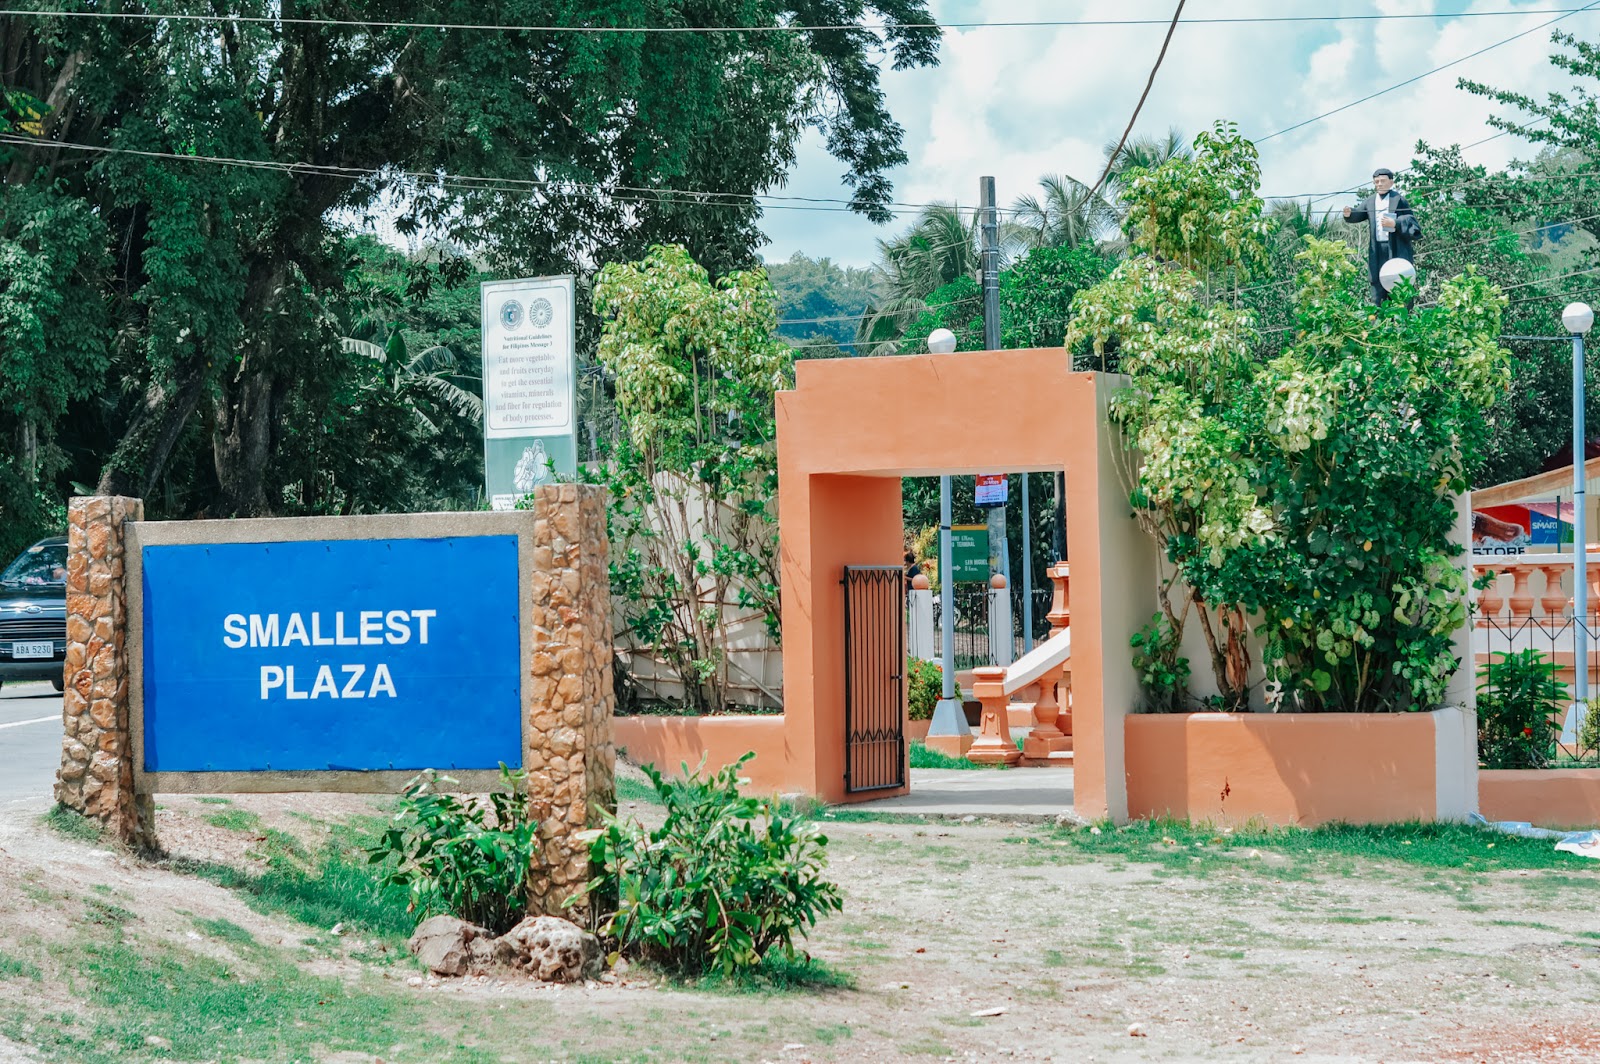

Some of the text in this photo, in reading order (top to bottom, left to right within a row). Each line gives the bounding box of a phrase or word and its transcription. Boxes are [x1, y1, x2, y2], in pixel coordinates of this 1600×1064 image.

[526, 354, 555, 363] vegetables
[511, 366, 527, 375] fruits
[528, 365, 554, 374] everyday
[508, 380, 517, 388] get
[518, 378, 527, 386] the
[529, 377, 553, 386] essential
[529, 389, 554, 397] minerals
[496, 402, 506, 411] and
[507, 402, 521, 410] fiber
[532, 400, 562, 409] regulation
[502, 414, 509, 422] of
[510, 414, 523, 423] body
[1532, 519, 1557, 530] SMART
[1472, 547, 1526, 555] STORE
[223, 609, 437, 649] SMALLEST
[15, 644, 52, 654] ABA 5230
[260, 663, 398, 700] PLAZA
